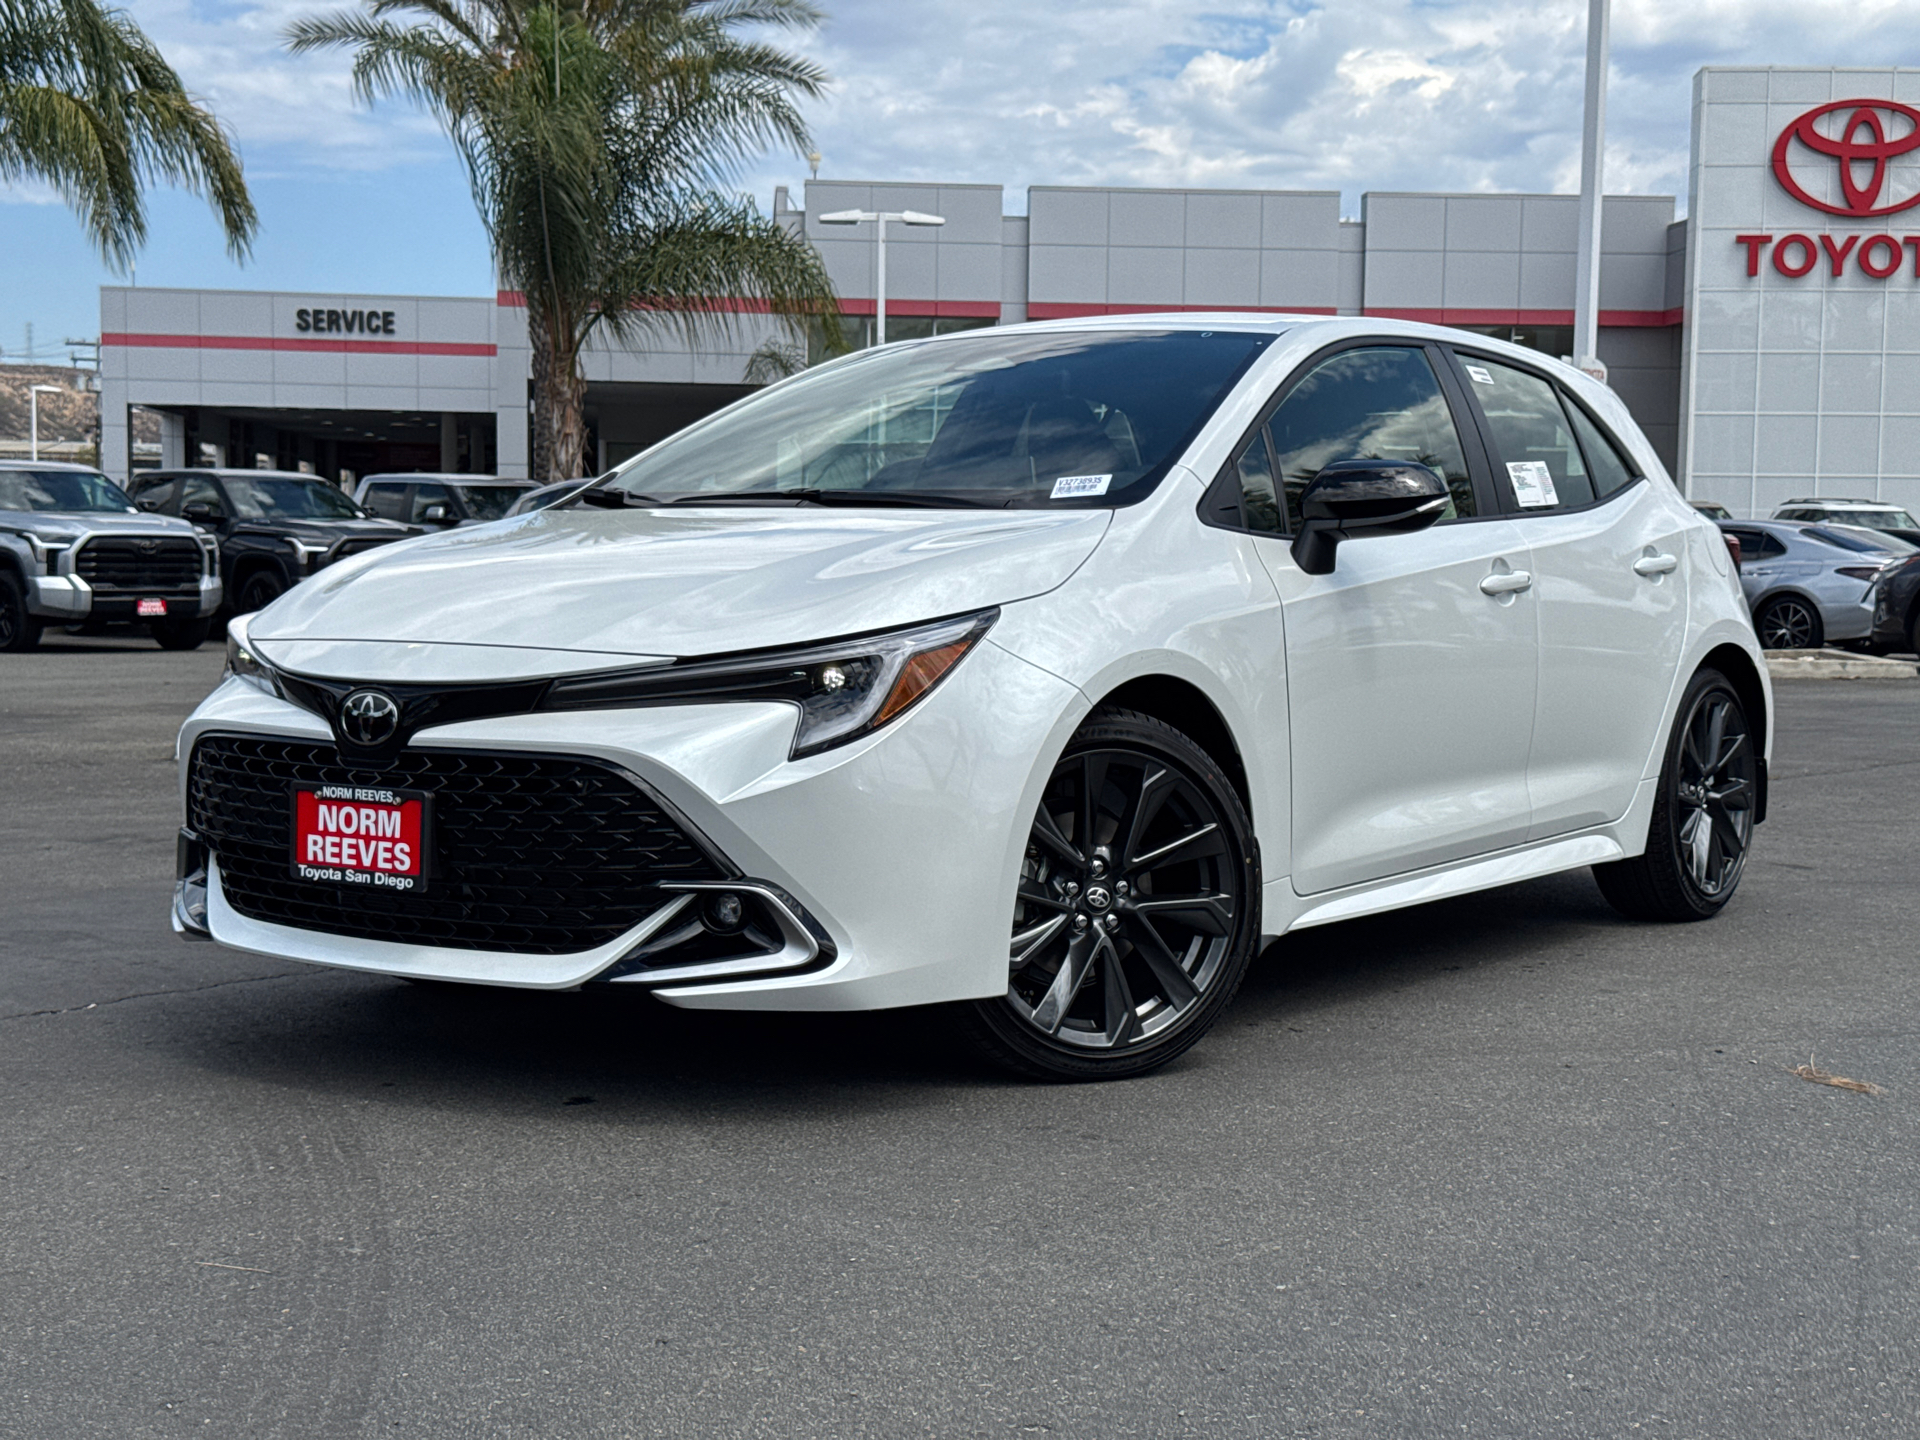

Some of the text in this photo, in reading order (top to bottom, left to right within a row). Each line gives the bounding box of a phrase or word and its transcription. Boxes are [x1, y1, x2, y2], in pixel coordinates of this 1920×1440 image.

[296, 308, 396, 335] SERVICE
[322, 786, 394, 803] NORM REEVES
[318, 804, 402, 839] NORM
[307, 833, 411, 872] REEVES
[298, 864, 414, 890] Toyota San Diego
